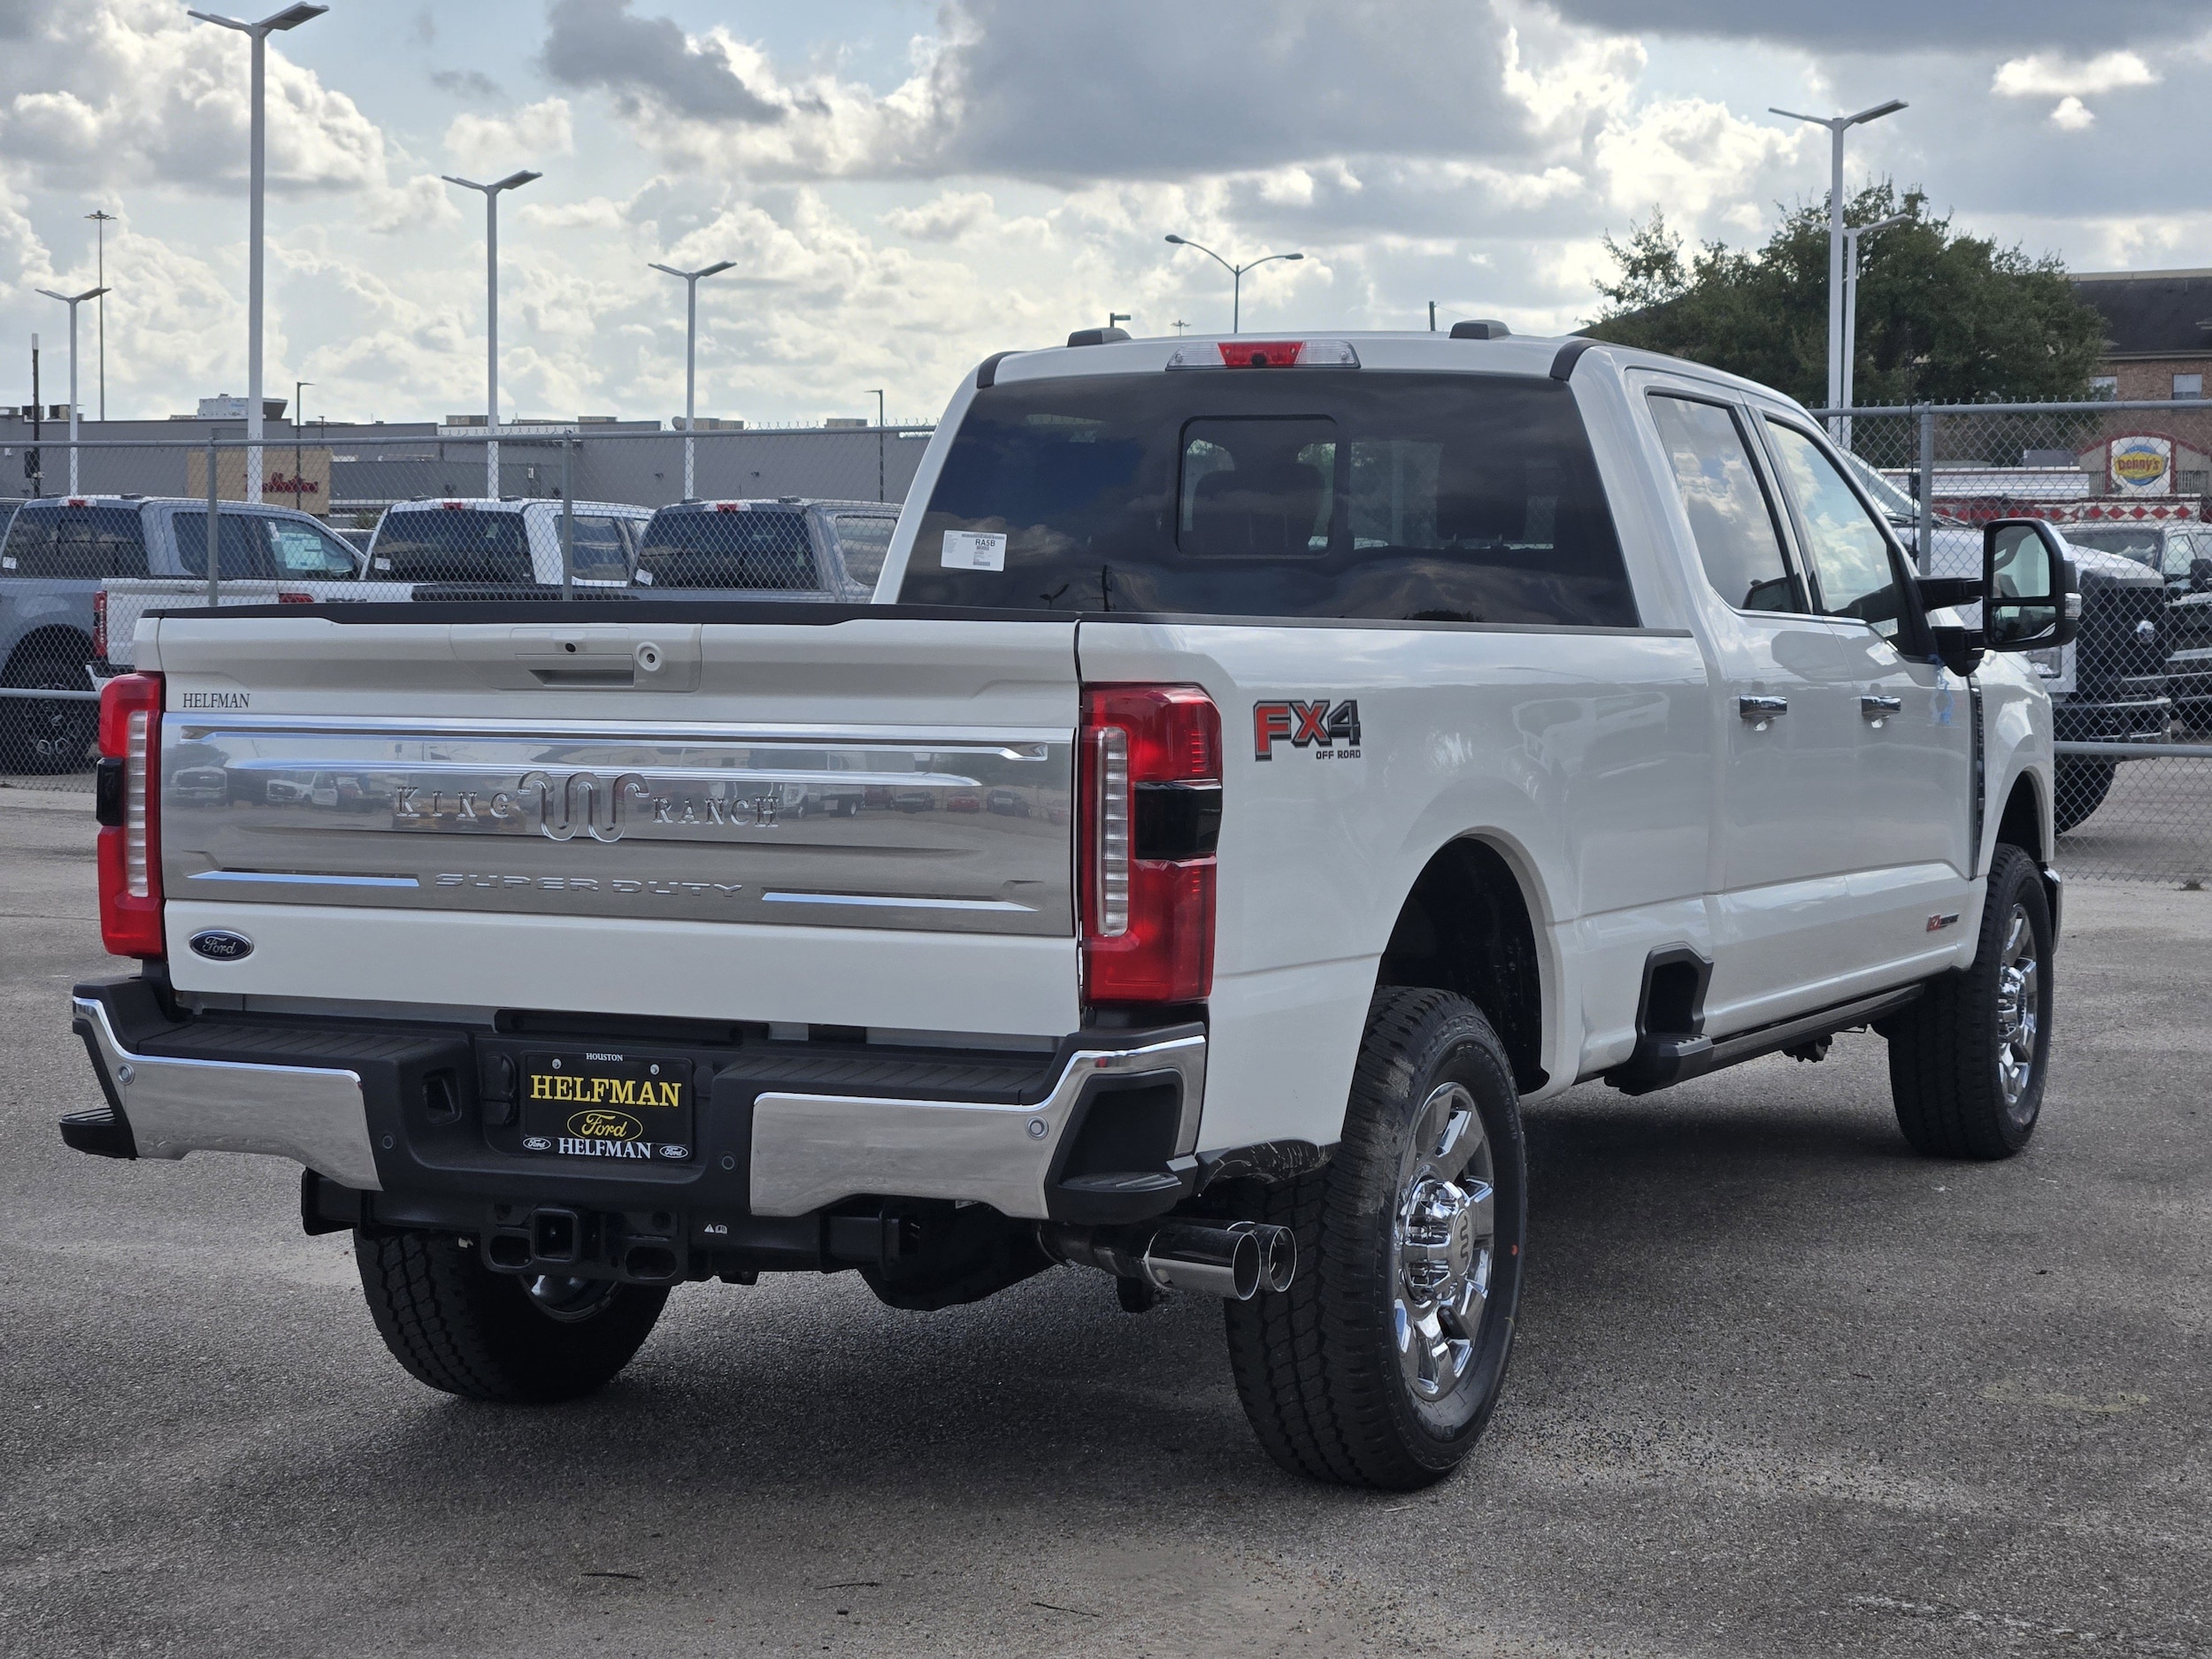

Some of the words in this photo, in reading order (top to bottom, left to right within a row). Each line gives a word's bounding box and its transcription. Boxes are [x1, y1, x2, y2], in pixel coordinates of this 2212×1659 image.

[2117, 457, 2161, 472] Denny's
[183, 693, 250, 709] HELFMAN
[1253, 699, 1361, 762] FX4
[1316, 750, 1334, 759] OFF
[1337, 749, 1361, 759] ROAD
[396, 786, 510, 818] KING
[652, 796, 780, 827] RANCH
[434, 872, 599, 892] SUPER
[612, 879, 742, 897] DUTY
[202, 936, 237, 955] Ford
[586, 1052, 623, 1062] HOUSTON
[530, 1074, 682, 1107] HELFMAN
[580, 1112, 627, 1138] Ford
[527, 1139, 546, 1148] Ford
[558, 1137, 651, 1159] HELFMAN
[664, 1147, 683, 1157] Ford
